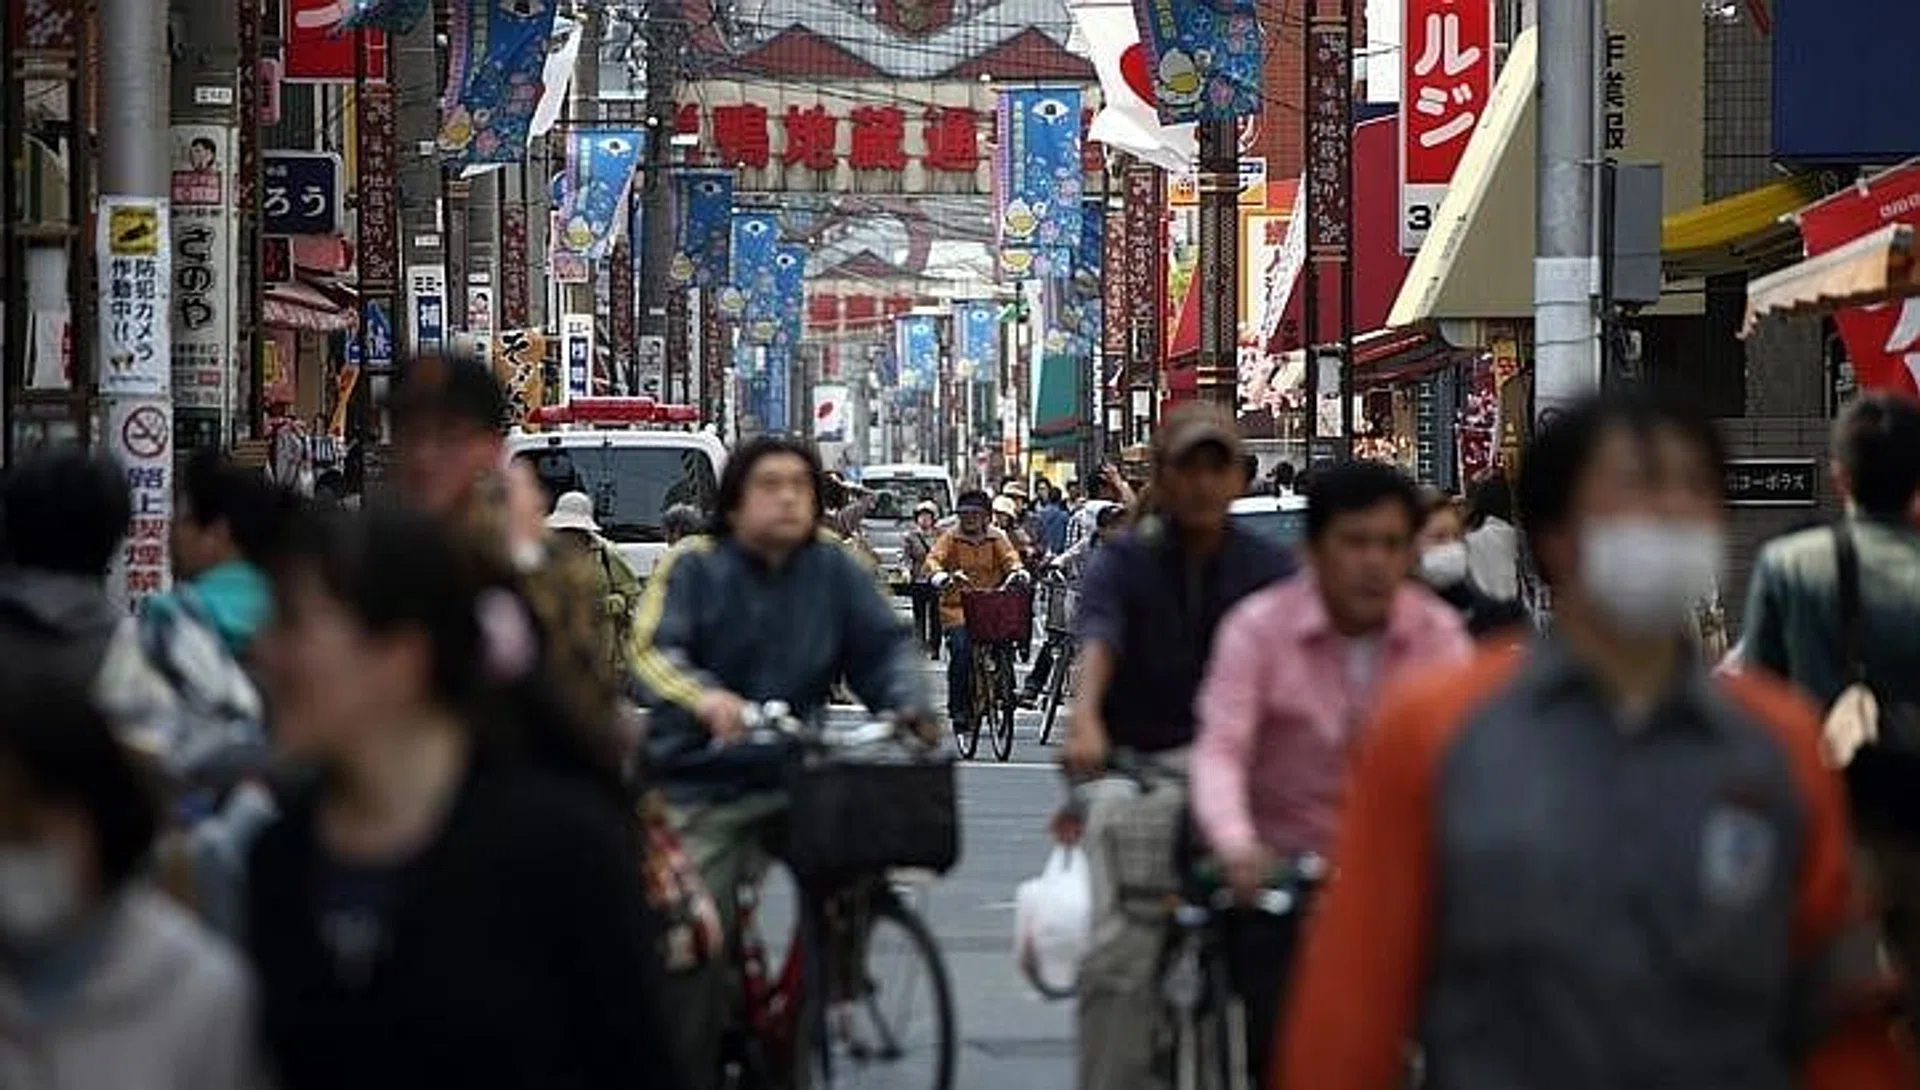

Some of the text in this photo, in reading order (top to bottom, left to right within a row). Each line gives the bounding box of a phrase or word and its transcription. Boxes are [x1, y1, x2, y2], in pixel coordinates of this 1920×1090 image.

[1415, 0, 1480, 147] ルジ
[1408, 204, 1440, 231] 3
[135, 259, 156, 361] 防犯カメラ
[1727, 473, 1804, 490] コーポラス
[127, 467, 163, 615] 路上喫煙禁
